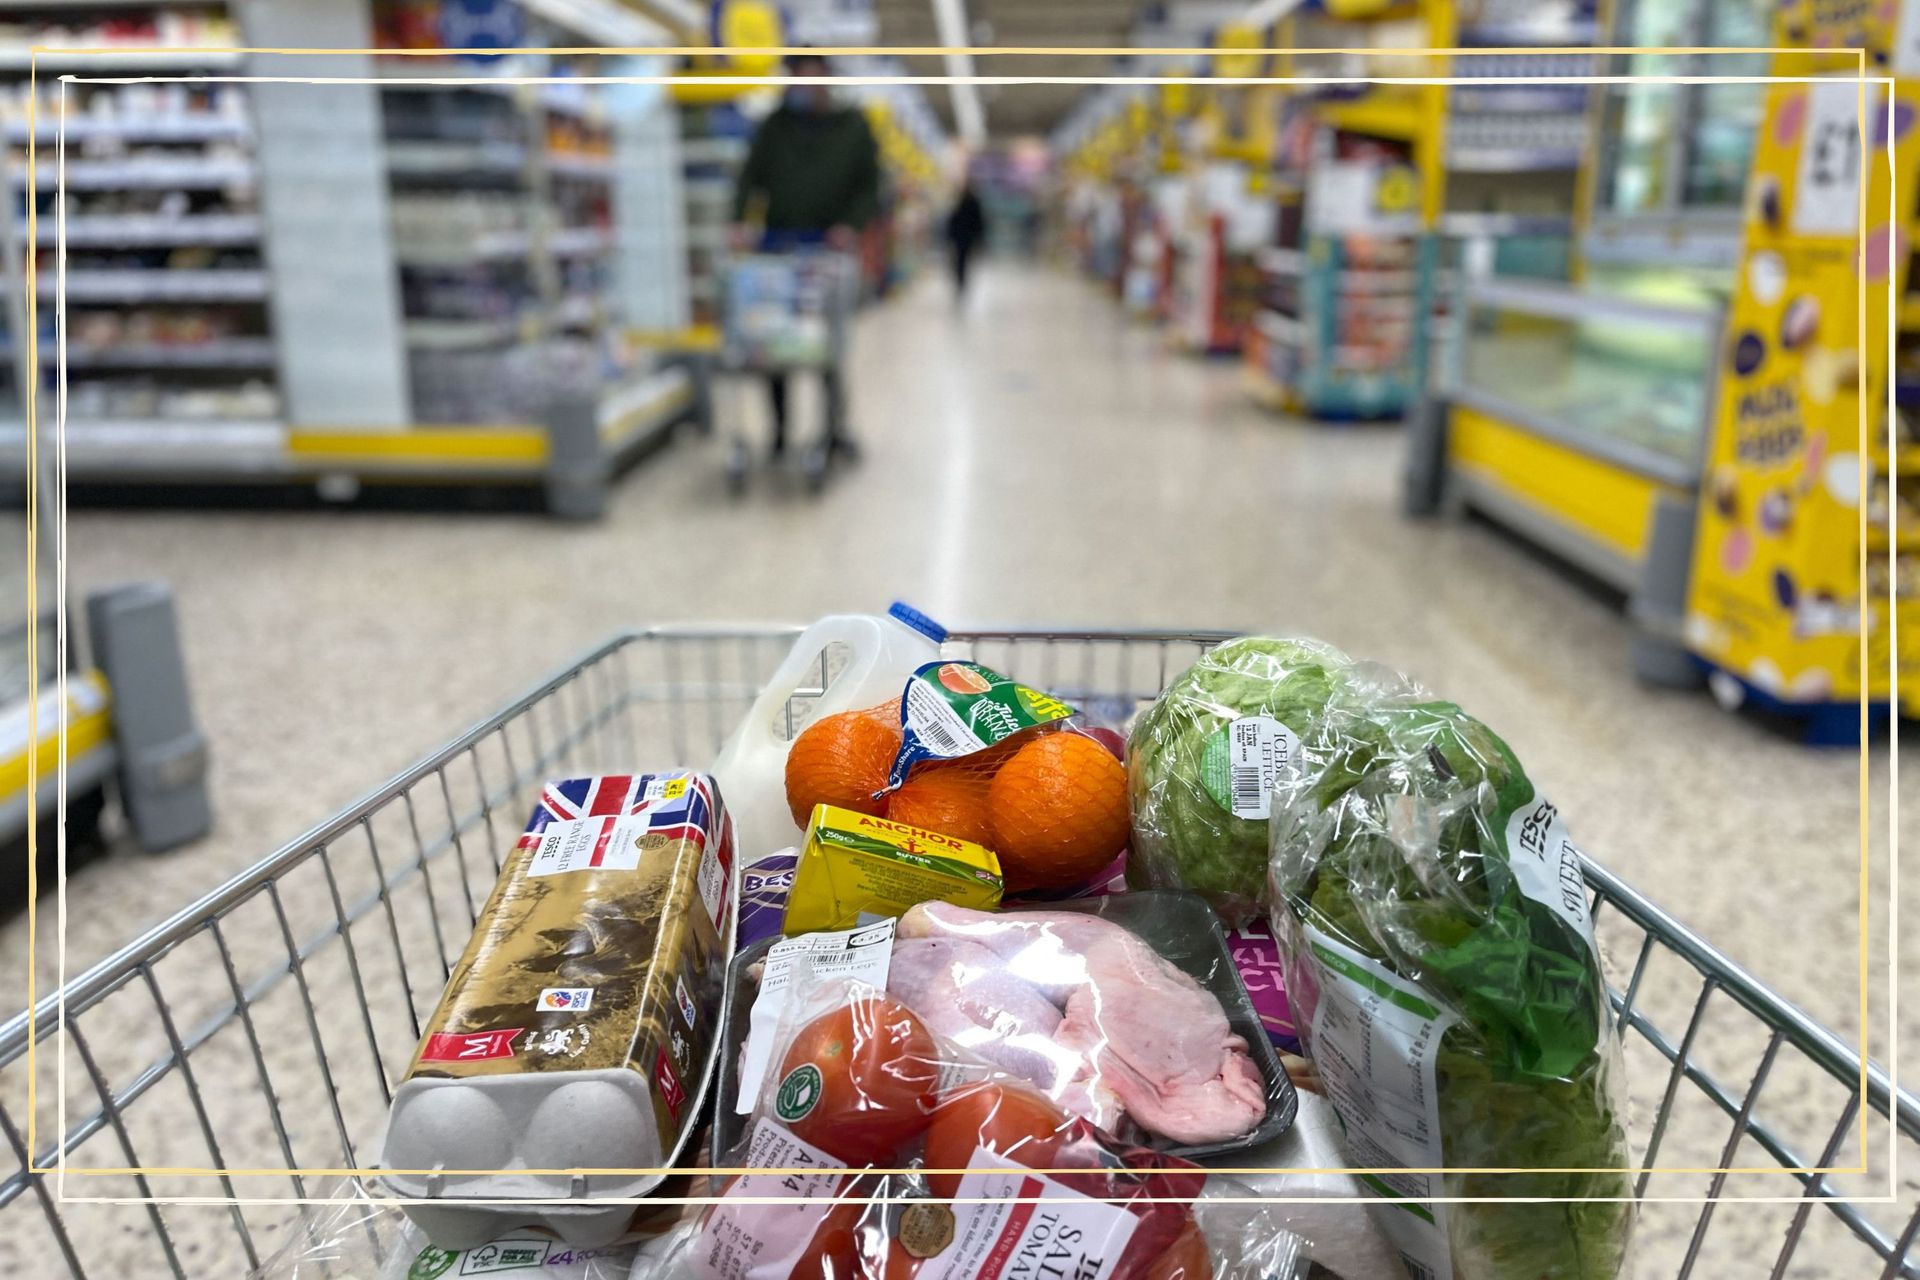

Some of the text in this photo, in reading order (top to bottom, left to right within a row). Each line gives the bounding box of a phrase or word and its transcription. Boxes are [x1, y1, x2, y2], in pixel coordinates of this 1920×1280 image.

[969, 700, 1011, 742] ORANG
[1262, 742, 1274, 792] LETTUCE
[1273, 734, 1288, 774] ICEB
[541, 836, 558, 860] TESCO
[576, 834, 592, 852] EGGS
[859, 817, 964, 851] ANCHOR
[896, 851, 932, 864] BUTTER
[1559, 839, 1584, 922] SWEET
[459, 1035, 493, 1058] M
